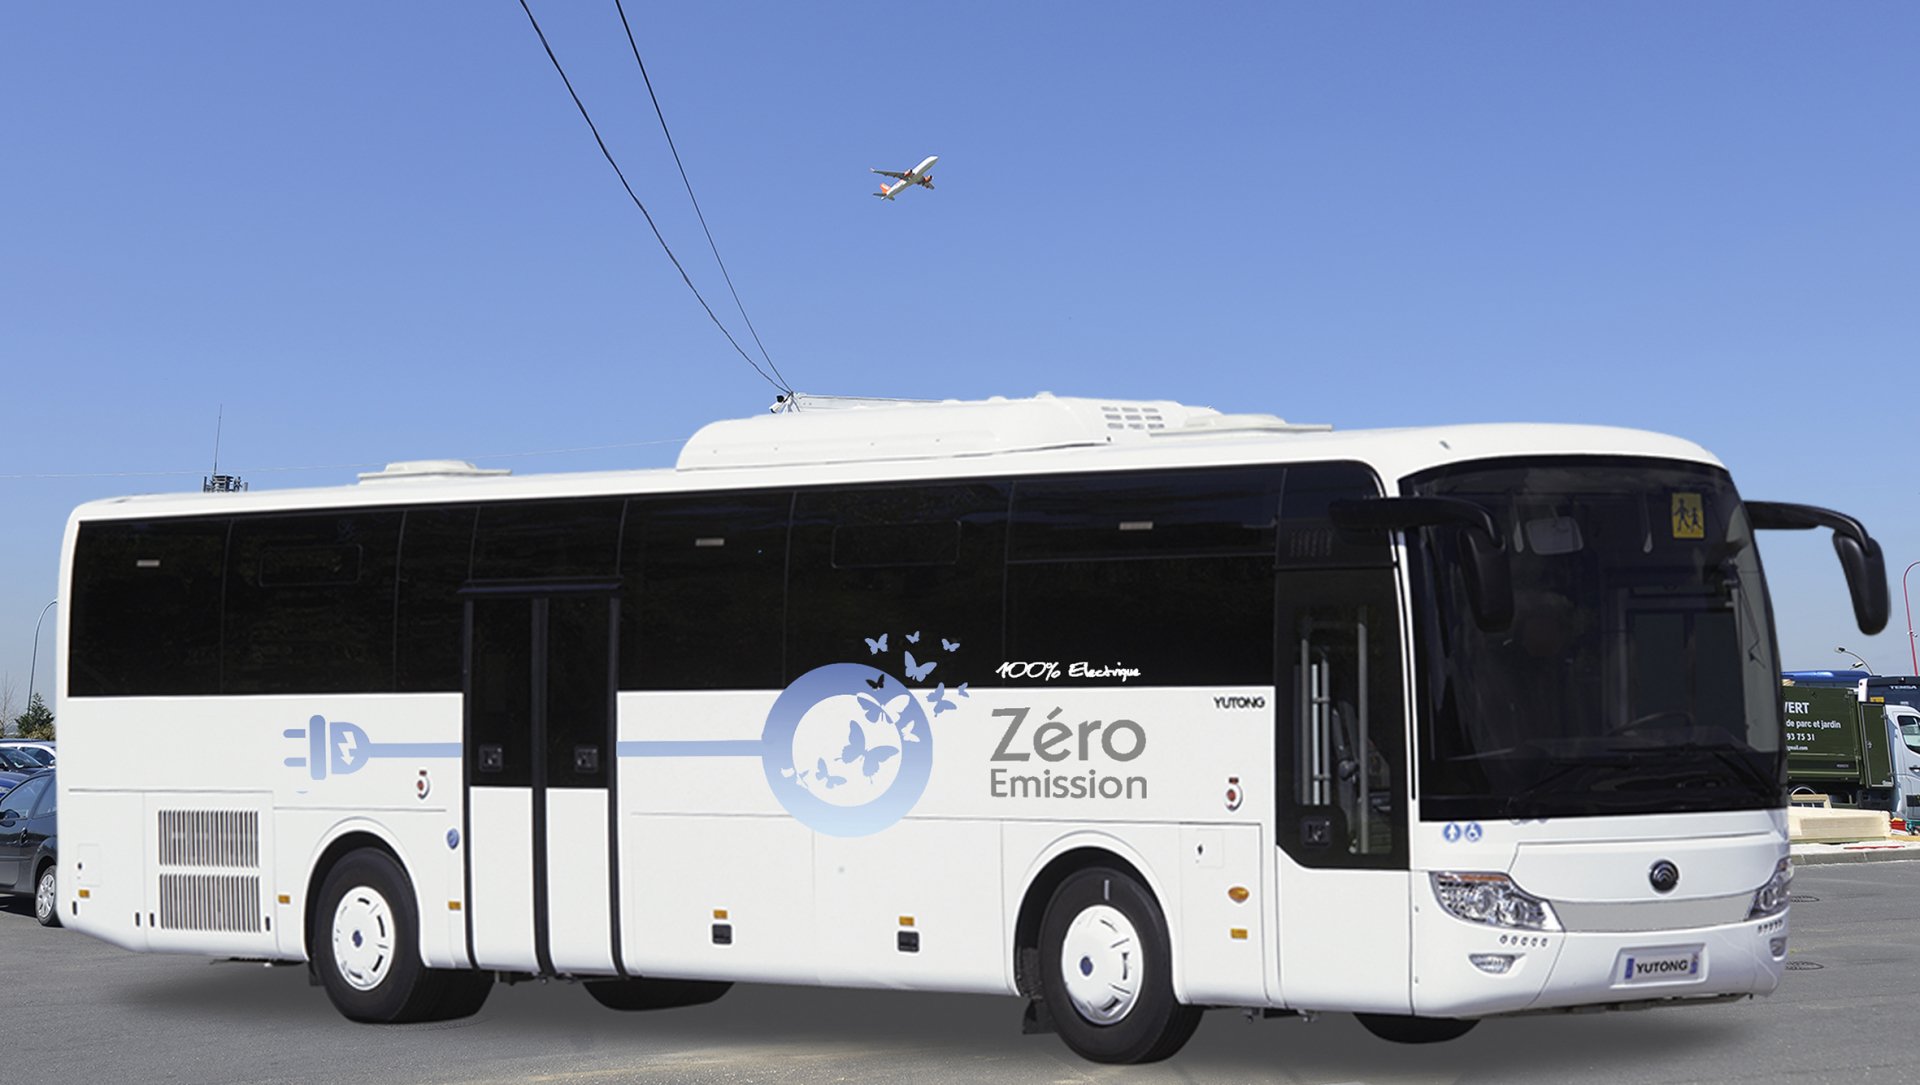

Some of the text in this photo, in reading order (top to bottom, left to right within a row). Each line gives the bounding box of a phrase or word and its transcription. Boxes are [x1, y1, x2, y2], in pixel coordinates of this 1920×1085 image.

[995, 661, 1142, 683] 100% Electrique
[1213, 696, 1266, 709] YUTONG
[1796, 720, 1812, 729] parc
[1812, 720, 1821, 728] et
[1820, 720, 1842, 730] jardin
[990, 706, 1147, 763] Zéro
[1786, 732, 1815, 741] 93 75 31
[990, 768, 1148, 799] Emission
[1636, 960, 1688, 974] YUTONG
